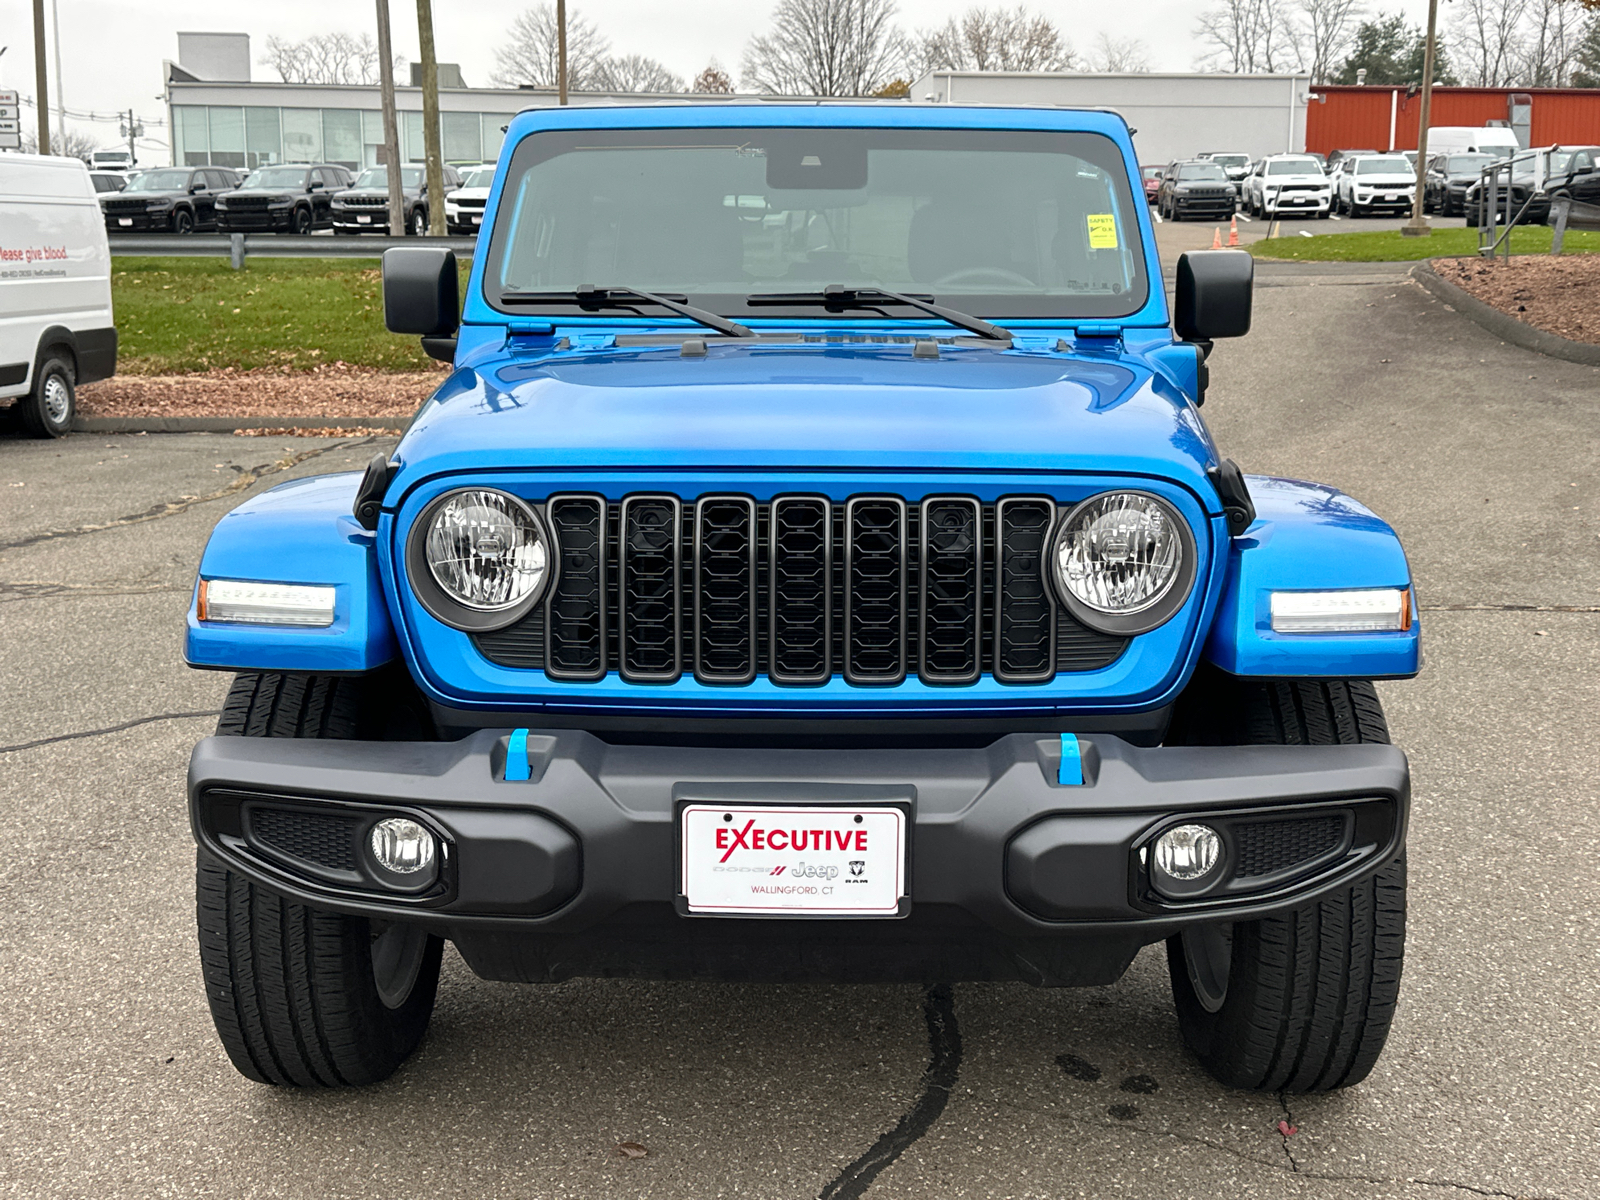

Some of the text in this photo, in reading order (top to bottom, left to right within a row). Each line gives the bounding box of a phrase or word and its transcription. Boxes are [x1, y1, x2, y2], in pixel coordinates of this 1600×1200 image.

[0, 245, 69, 264] lease give blood.
[716, 819, 868, 863] EXECUTIVE
[791, 861, 839, 881] Jeep
[750, 885, 834, 896] WALLINGFORD, CT
